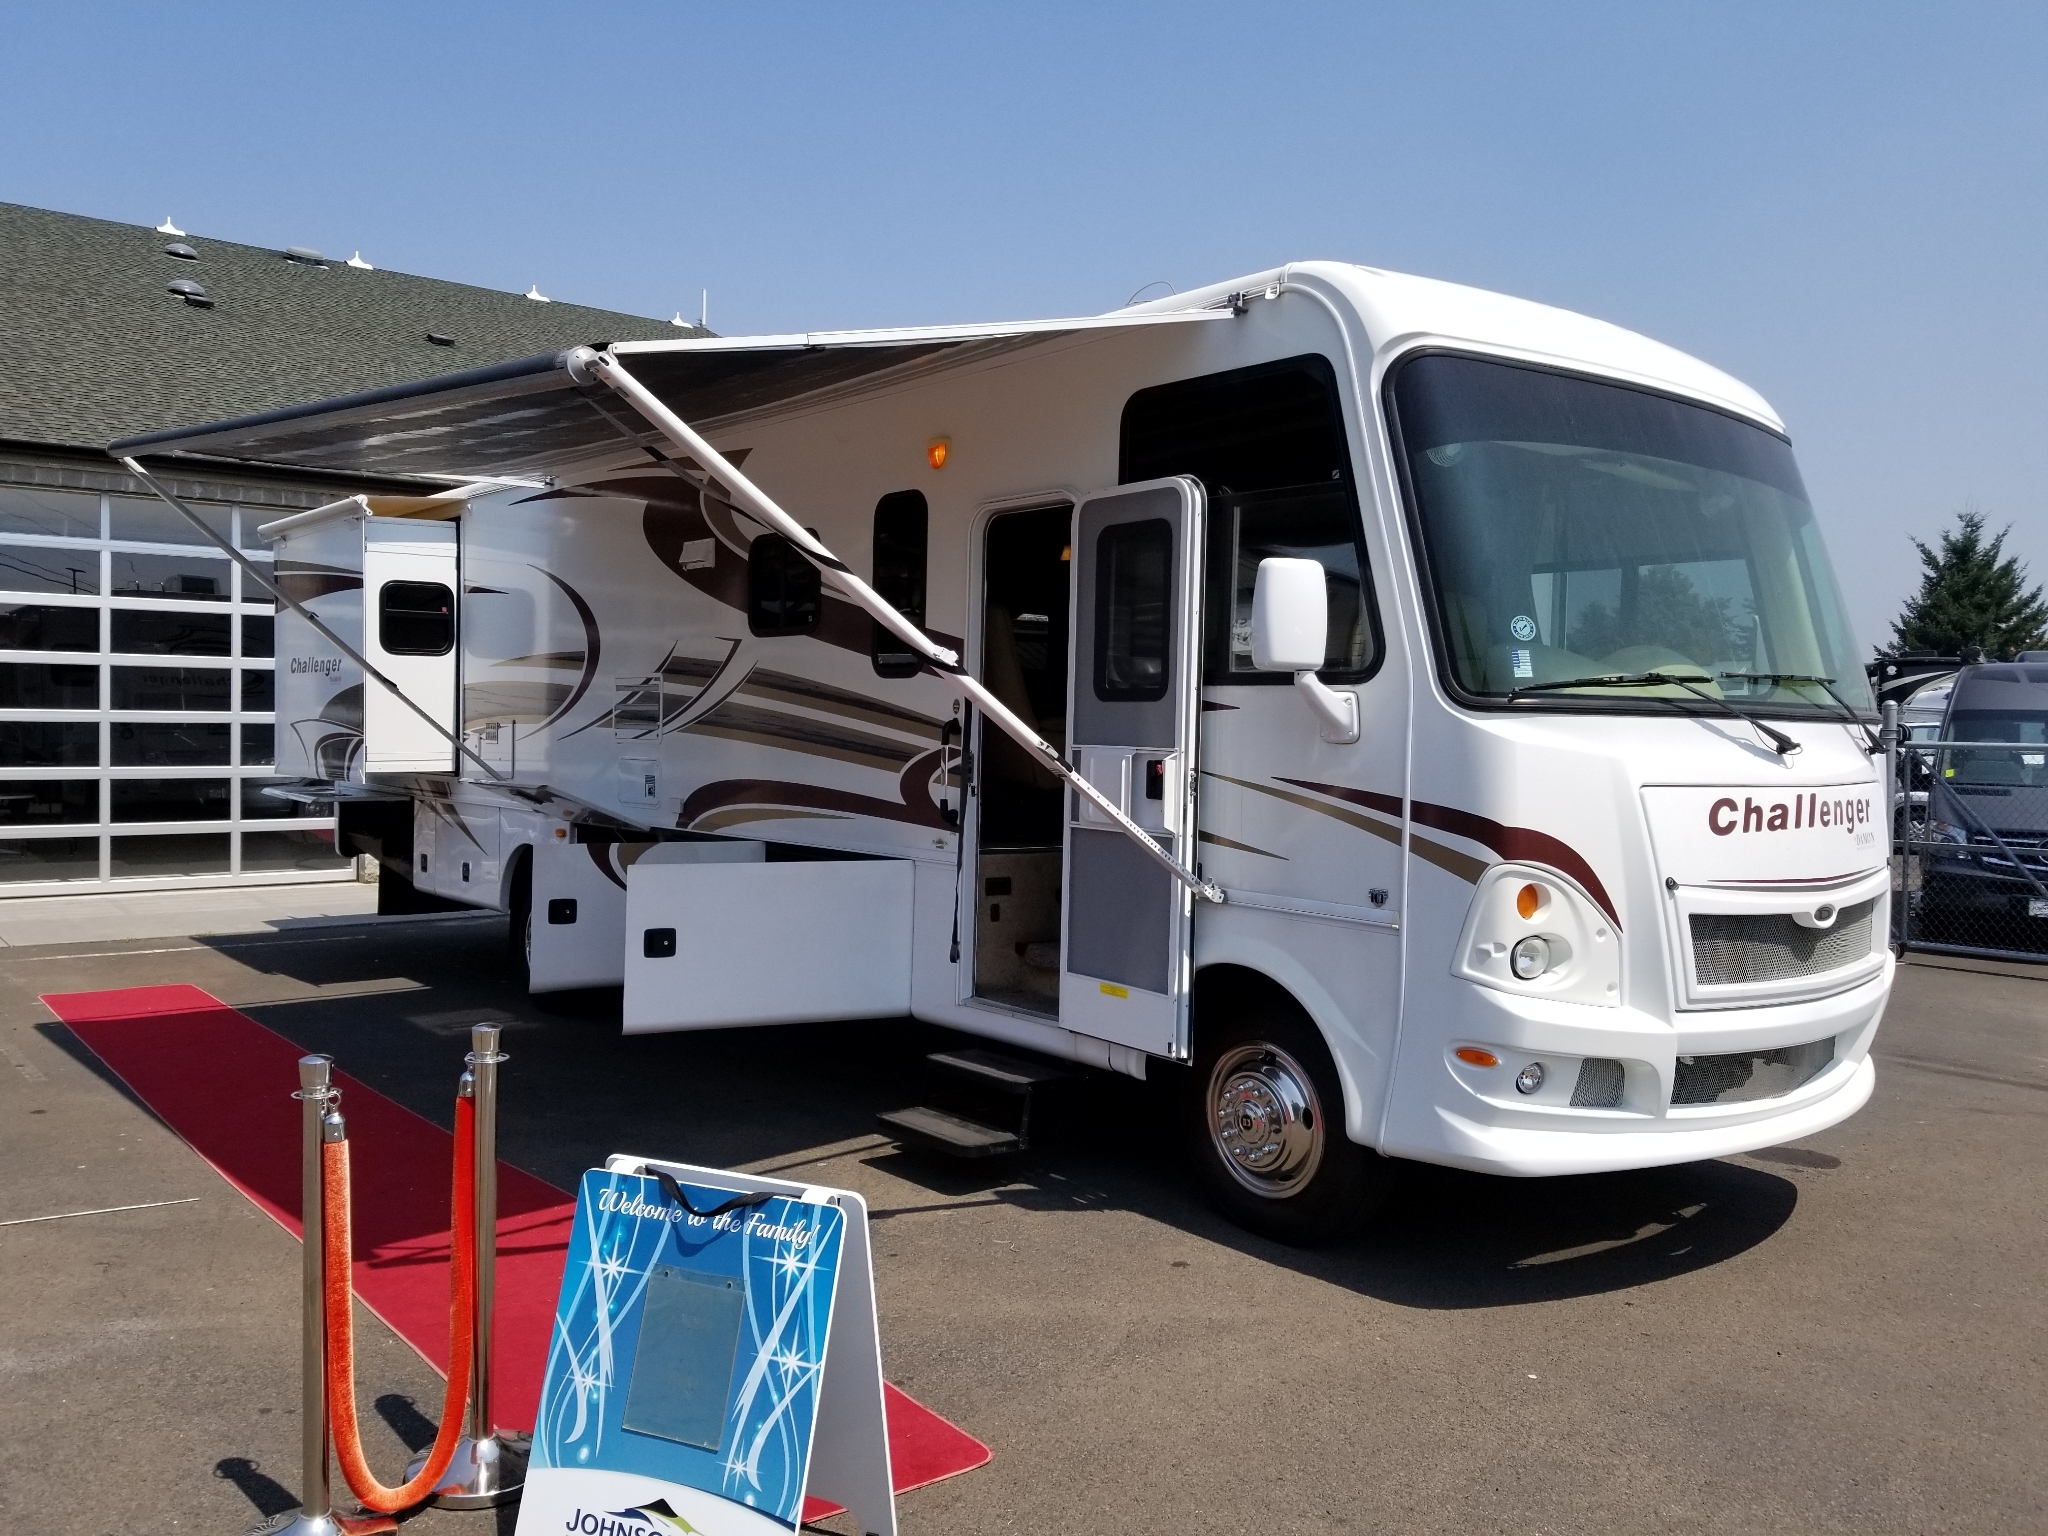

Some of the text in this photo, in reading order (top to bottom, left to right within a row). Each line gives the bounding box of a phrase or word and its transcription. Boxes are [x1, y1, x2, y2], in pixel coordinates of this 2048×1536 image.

[290, 656, 342, 677] Challenger
[1708, 793, 1871, 836] Challenger
[598, 1189, 821, 1250] Welcome to the Family!
[566, 1508, 671, 1536] JOHN
